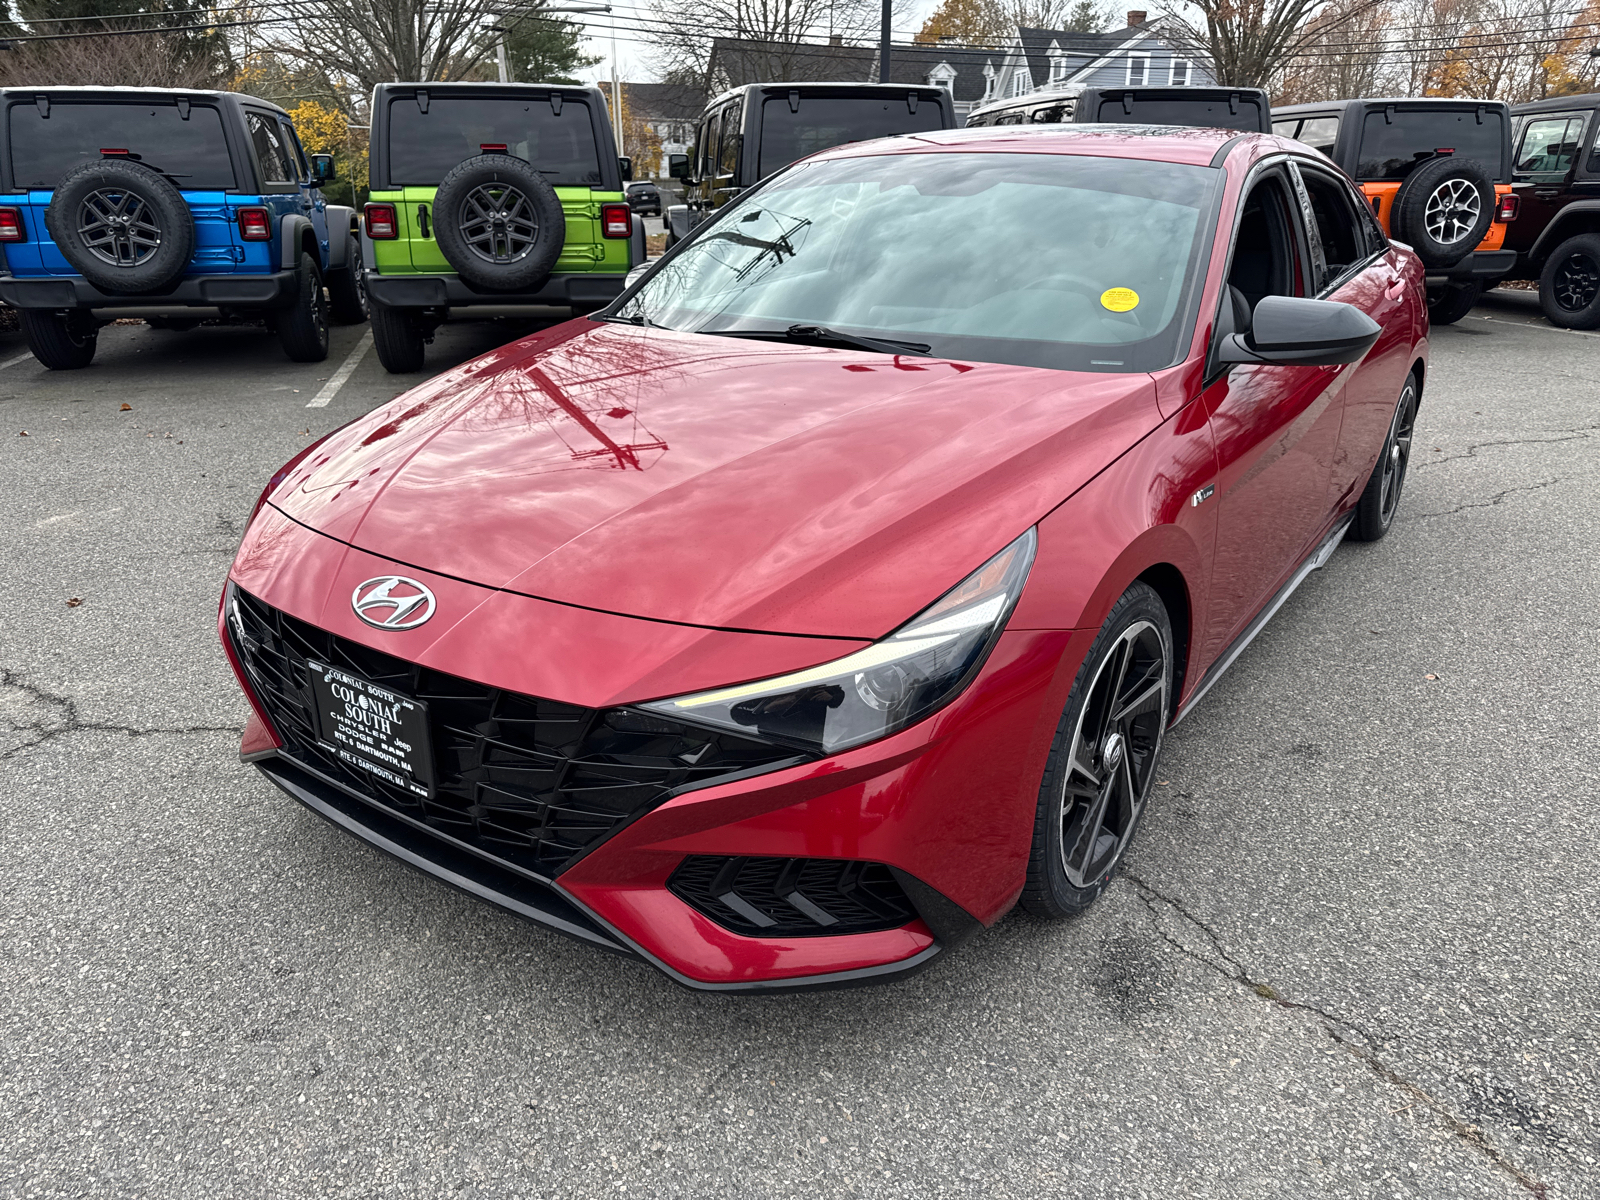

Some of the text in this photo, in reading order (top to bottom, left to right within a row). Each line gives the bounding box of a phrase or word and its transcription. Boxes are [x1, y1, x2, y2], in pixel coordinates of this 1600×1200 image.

[1191, 489, 1203, 507] N
[329, 670, 395, 703] COLONIAL SOUTH
[331, 683, 402, 725] COLONIAL
[330, 711, 387, 741] CHRYSLER
[345, 703, 392, 735] SOUTH
[338, 723, 374, 744] DODGE
[394, 737, 412, 753] Jeep
[356, 741, 401, 768] DARTMOUTH,
[401, 761, 412, 772] MA
[381, 743, 406, 758] RAM
[358, 759, 395, 784] DARTMOUTH,
[395, 776, 405, 787] MA
[410, 785, 428, 797] RAM
